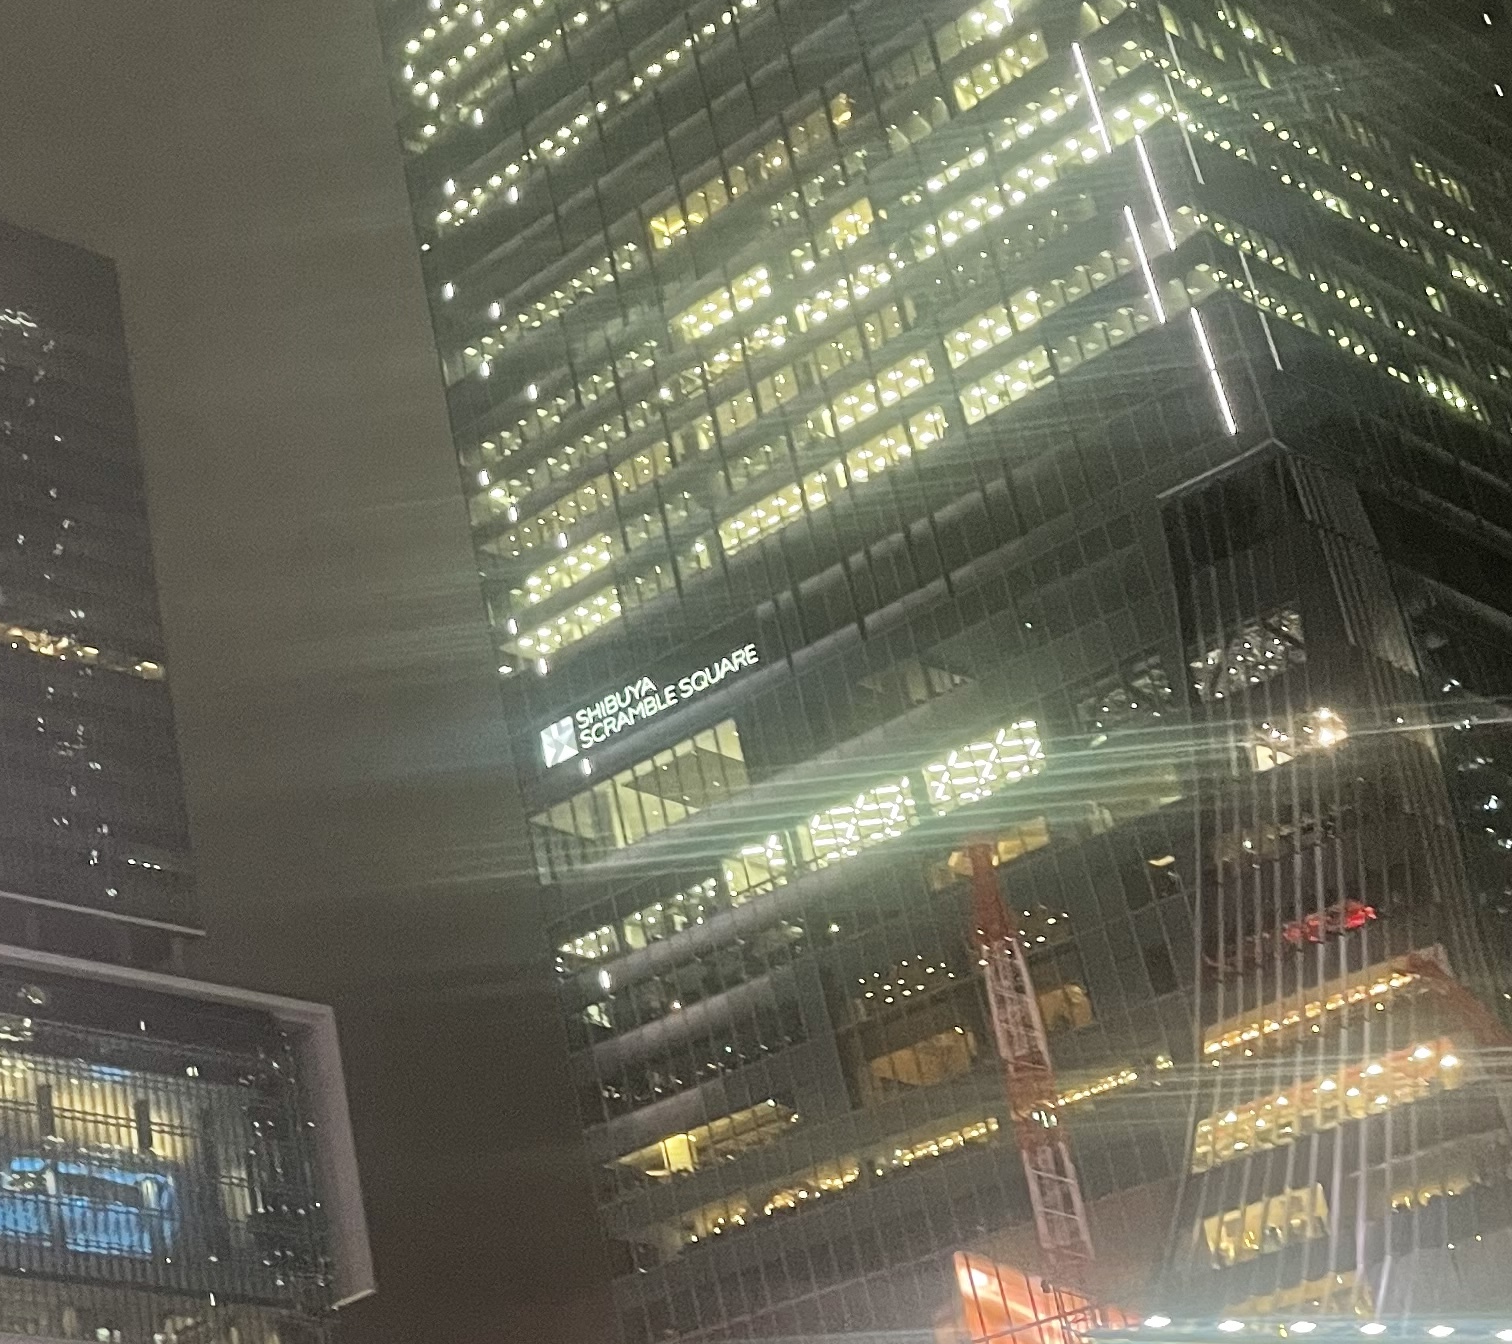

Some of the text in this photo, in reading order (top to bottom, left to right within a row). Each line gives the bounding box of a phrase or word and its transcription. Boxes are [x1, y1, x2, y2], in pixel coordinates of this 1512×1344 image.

[575, 676, 658, 729] SHIBUYA
[580, 643, 760, 749] SCRAMBLE SQUARE
